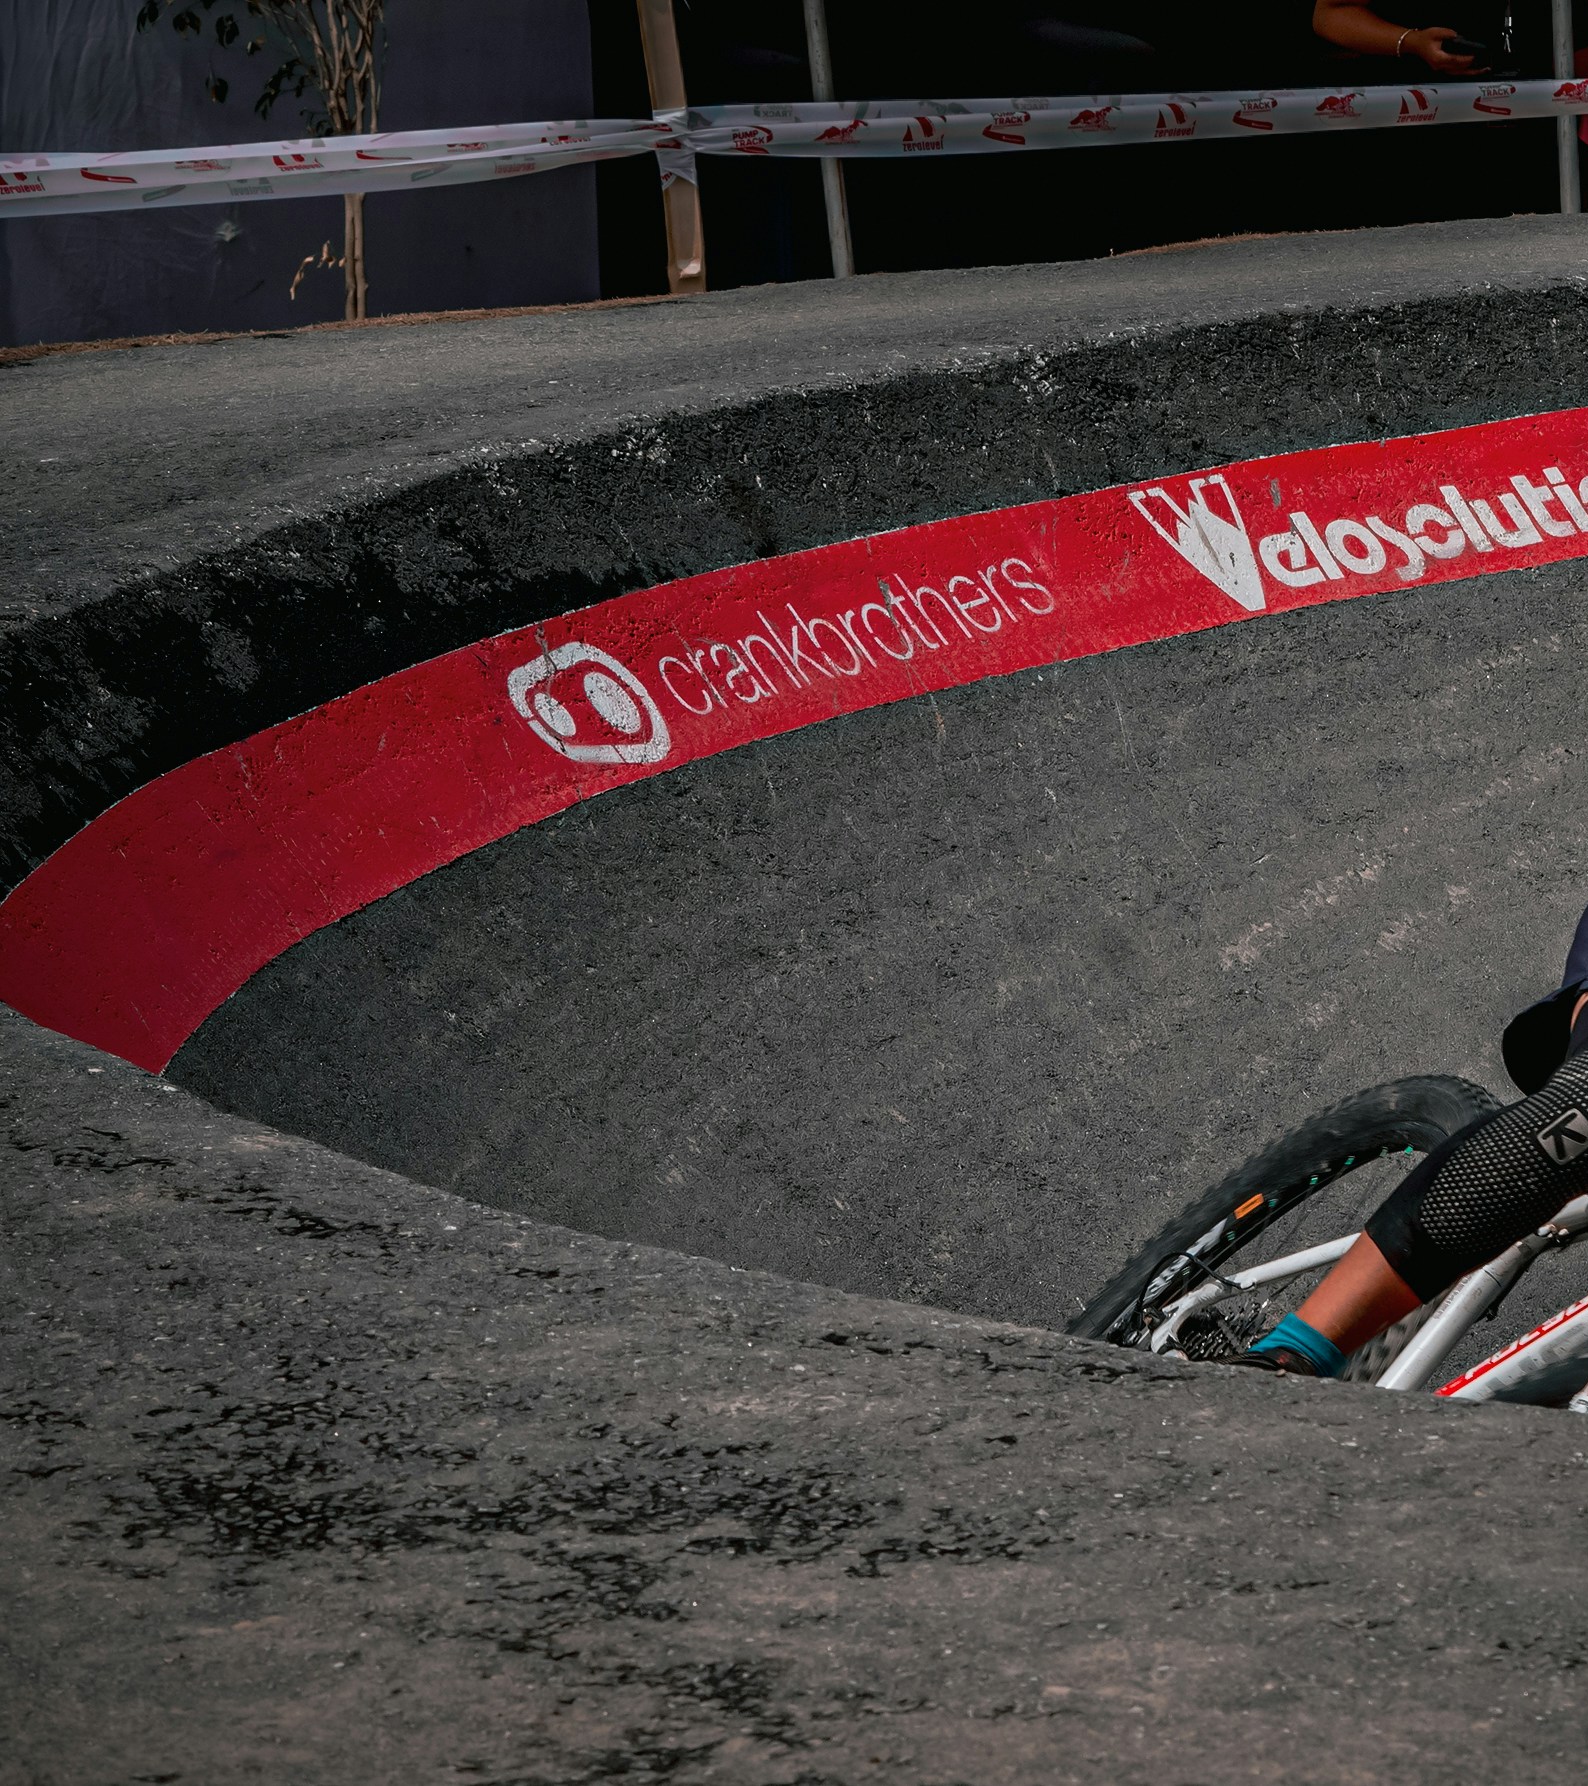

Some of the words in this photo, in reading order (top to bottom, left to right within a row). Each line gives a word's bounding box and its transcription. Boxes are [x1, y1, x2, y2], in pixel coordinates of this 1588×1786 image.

[1482, 88, 1510, 97] TRACK
[1242, 101, 1271, 110] TRACK
[993, 115, 1023, 125] TRACK
[732, 130, 758, 140] PUMP
[734, 137, 765, 149] TRACK
[902, 135, 944, 152] zerolevel
[658, 557, 1055, 716] crankbrothers
